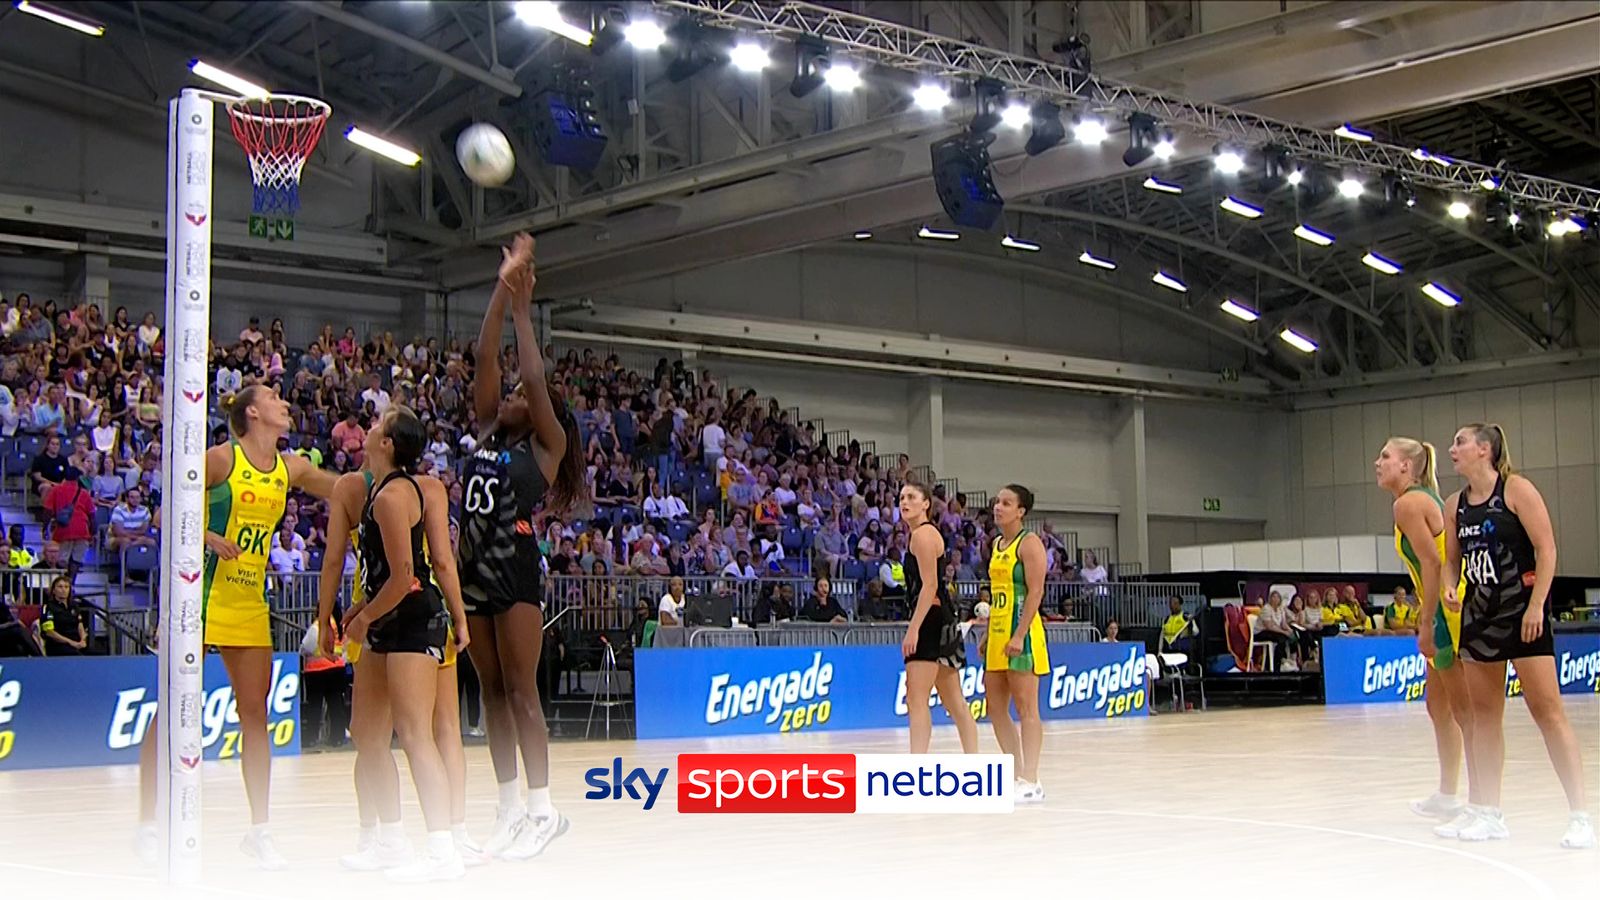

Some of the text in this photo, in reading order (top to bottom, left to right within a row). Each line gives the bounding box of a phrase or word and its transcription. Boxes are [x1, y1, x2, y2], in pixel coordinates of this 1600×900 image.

[465, 475, 499, 514] GS
[237, 526, 268, 556] GK
[1458, 525, 1481, 538] ANZ
[237, 568, 257, 579] VISIT
[1463, 550, 1499, 585] WA
[705, 651, 833, 724] Energade
[1049, 646, 1145, 710] Energade
[1363, 652, 1427, 695] Energad
[1106, 689, 1145, 717] zero
[1405, 680, 1427, 702] zer
[780, 700, 831, 732] zero
